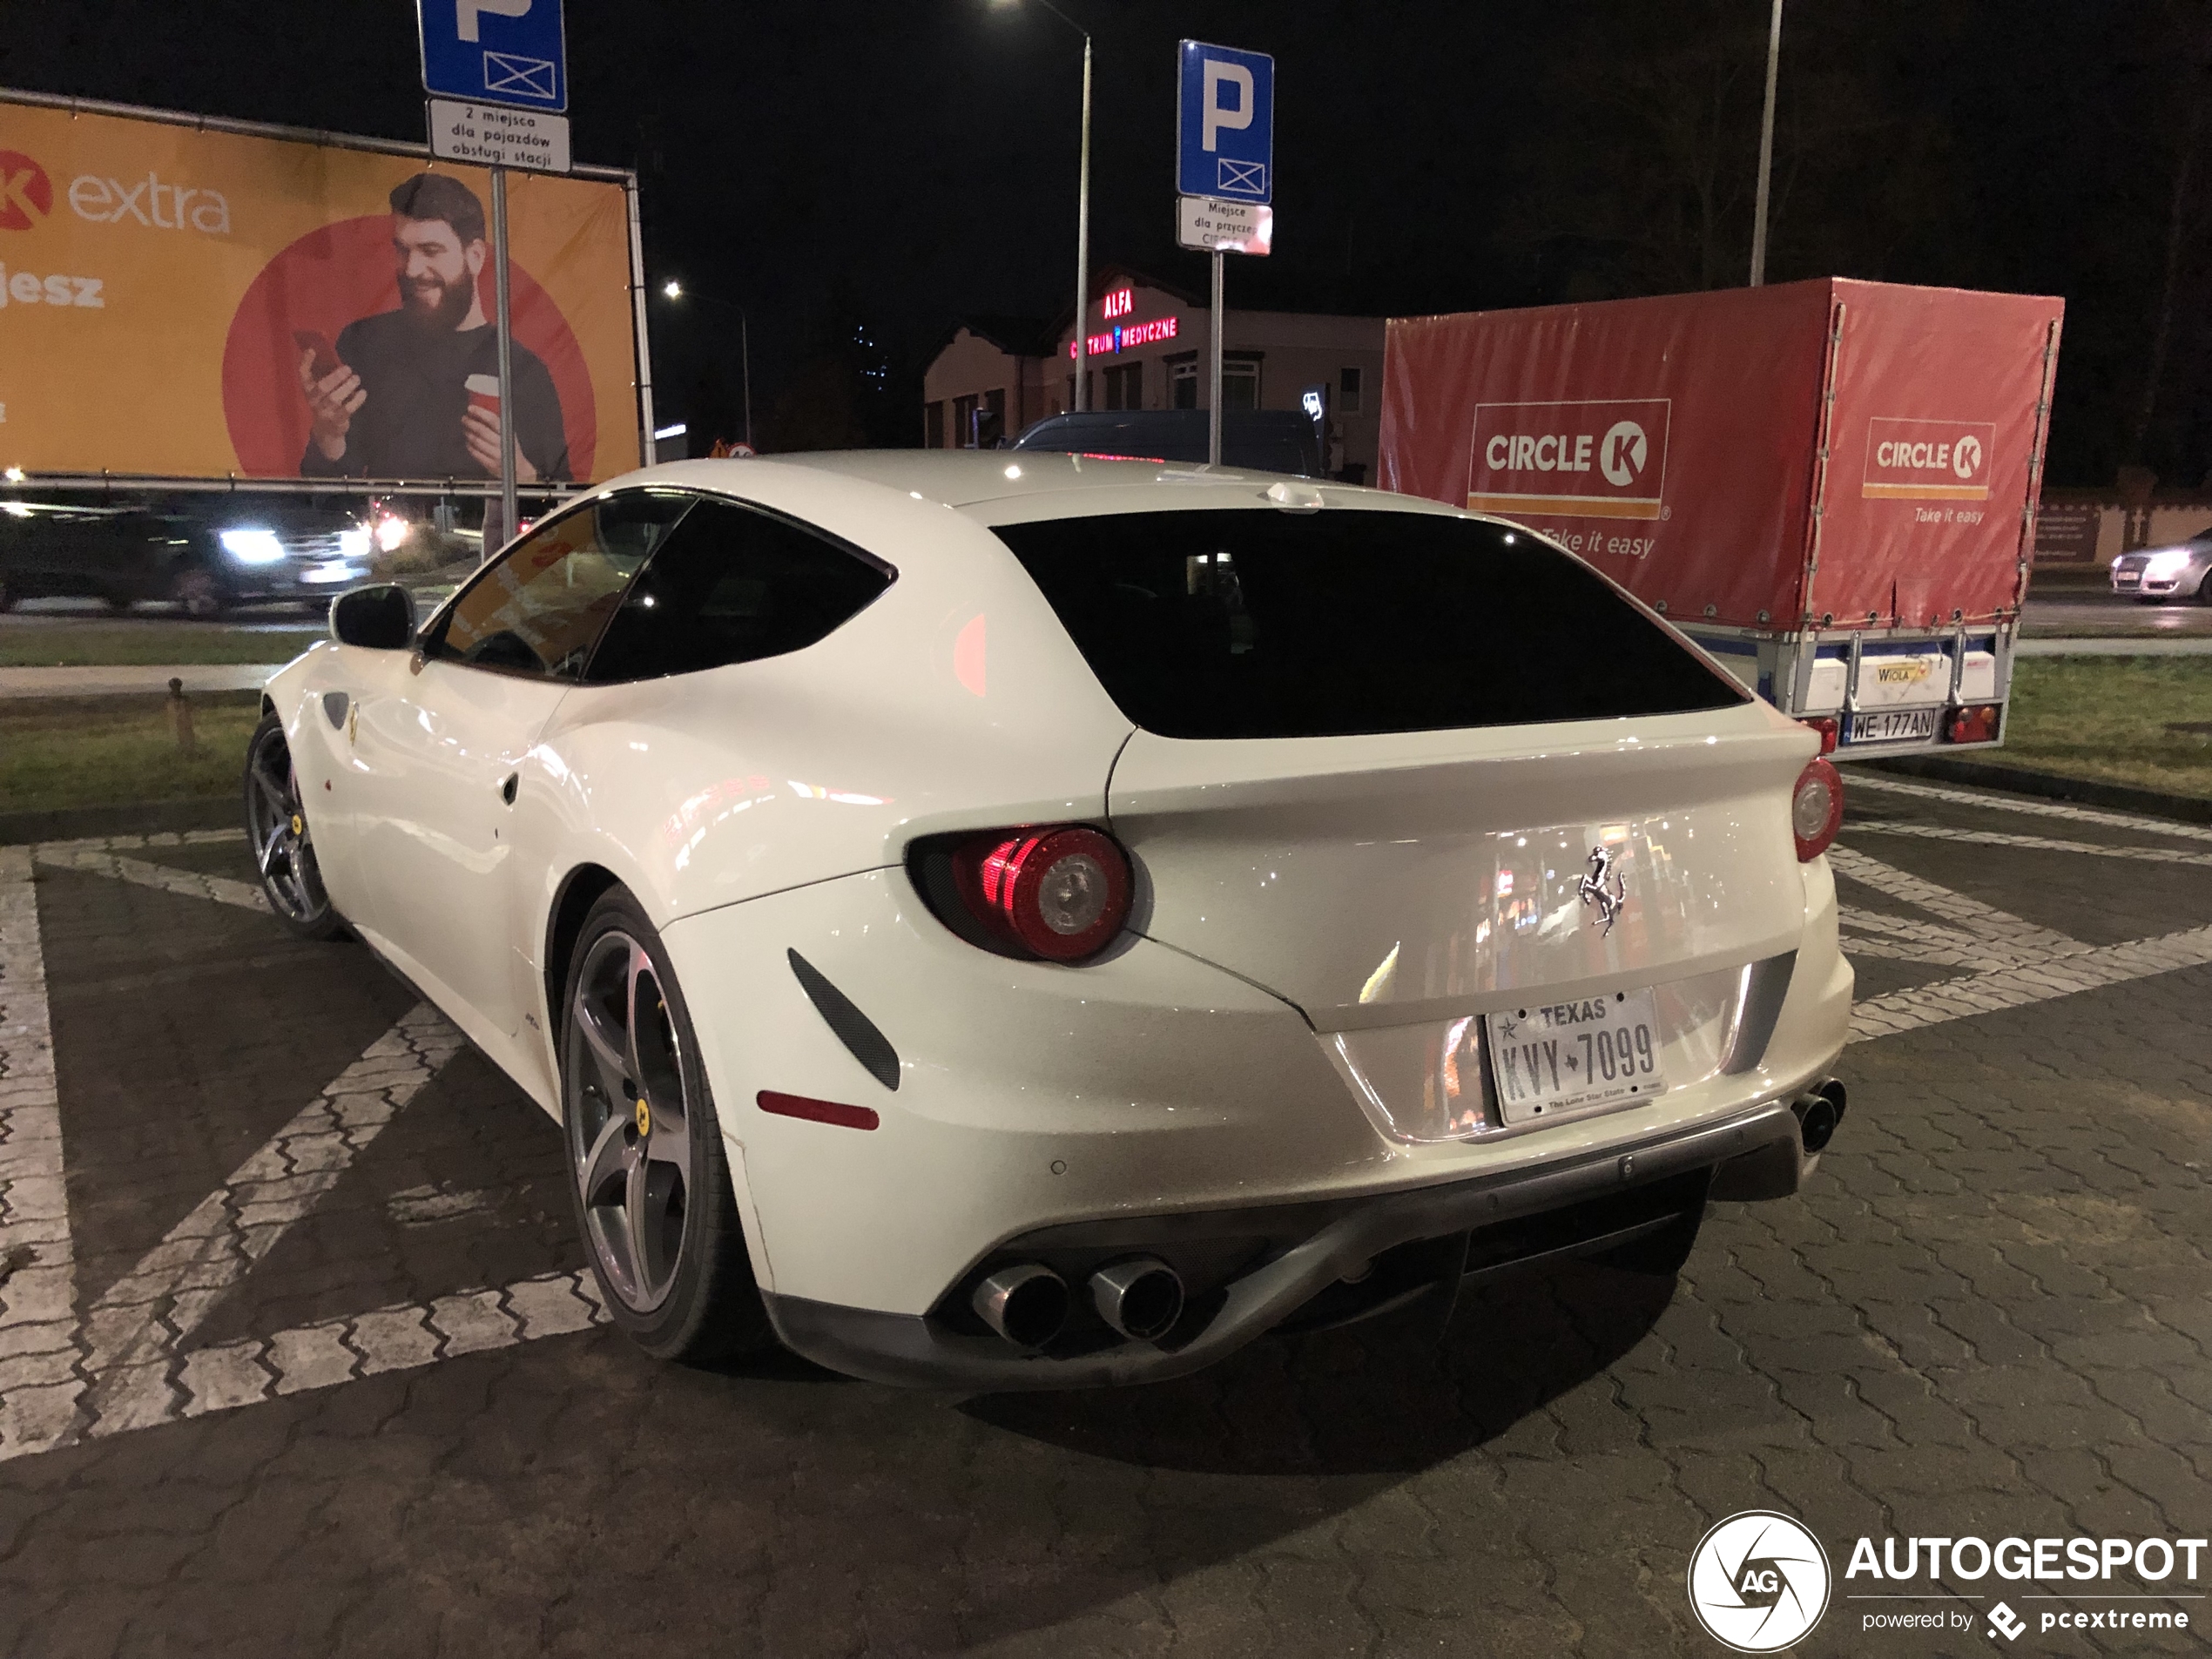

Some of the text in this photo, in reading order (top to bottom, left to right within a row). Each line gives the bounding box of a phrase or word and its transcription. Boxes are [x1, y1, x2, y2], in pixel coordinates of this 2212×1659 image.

[466, 107, 536, 127] 2 miejsca
[1203, 58, 1254, 152] P
[451, 124, 550, 147] dla pojazdów
[453, 144, 551, 168] obsługi stacji
[69, 171, 230, 234] extra
[1209, 202, 1245, 217] Miejsce
[1195, 217, 1211, 227] dla
[1103, 288, 1132, 320] ALFA
[1069, 318, 1177, 359] CTRUM MEDYCZNE
[1487, 431, 1642, 483] CIRCLE K
[1877, 441, 1979, 475] CIRCLE K
[1915, 507, 1985, 525] Take it easy
[1588, 530, 1603, 552] it
[1608, 536, 1655, 560] easy
[1854, 711, 1932, 738] WE 177AN
[1541, 999, 1607, 1028] TEXAS
[1502, 1023, 1654, 1101] KVY 7099
[1565, 1096, 1585, 1106] Lone
[1587, 1092, 1602, 1102] Star
[1603, 1088, 1626, 1098] State
